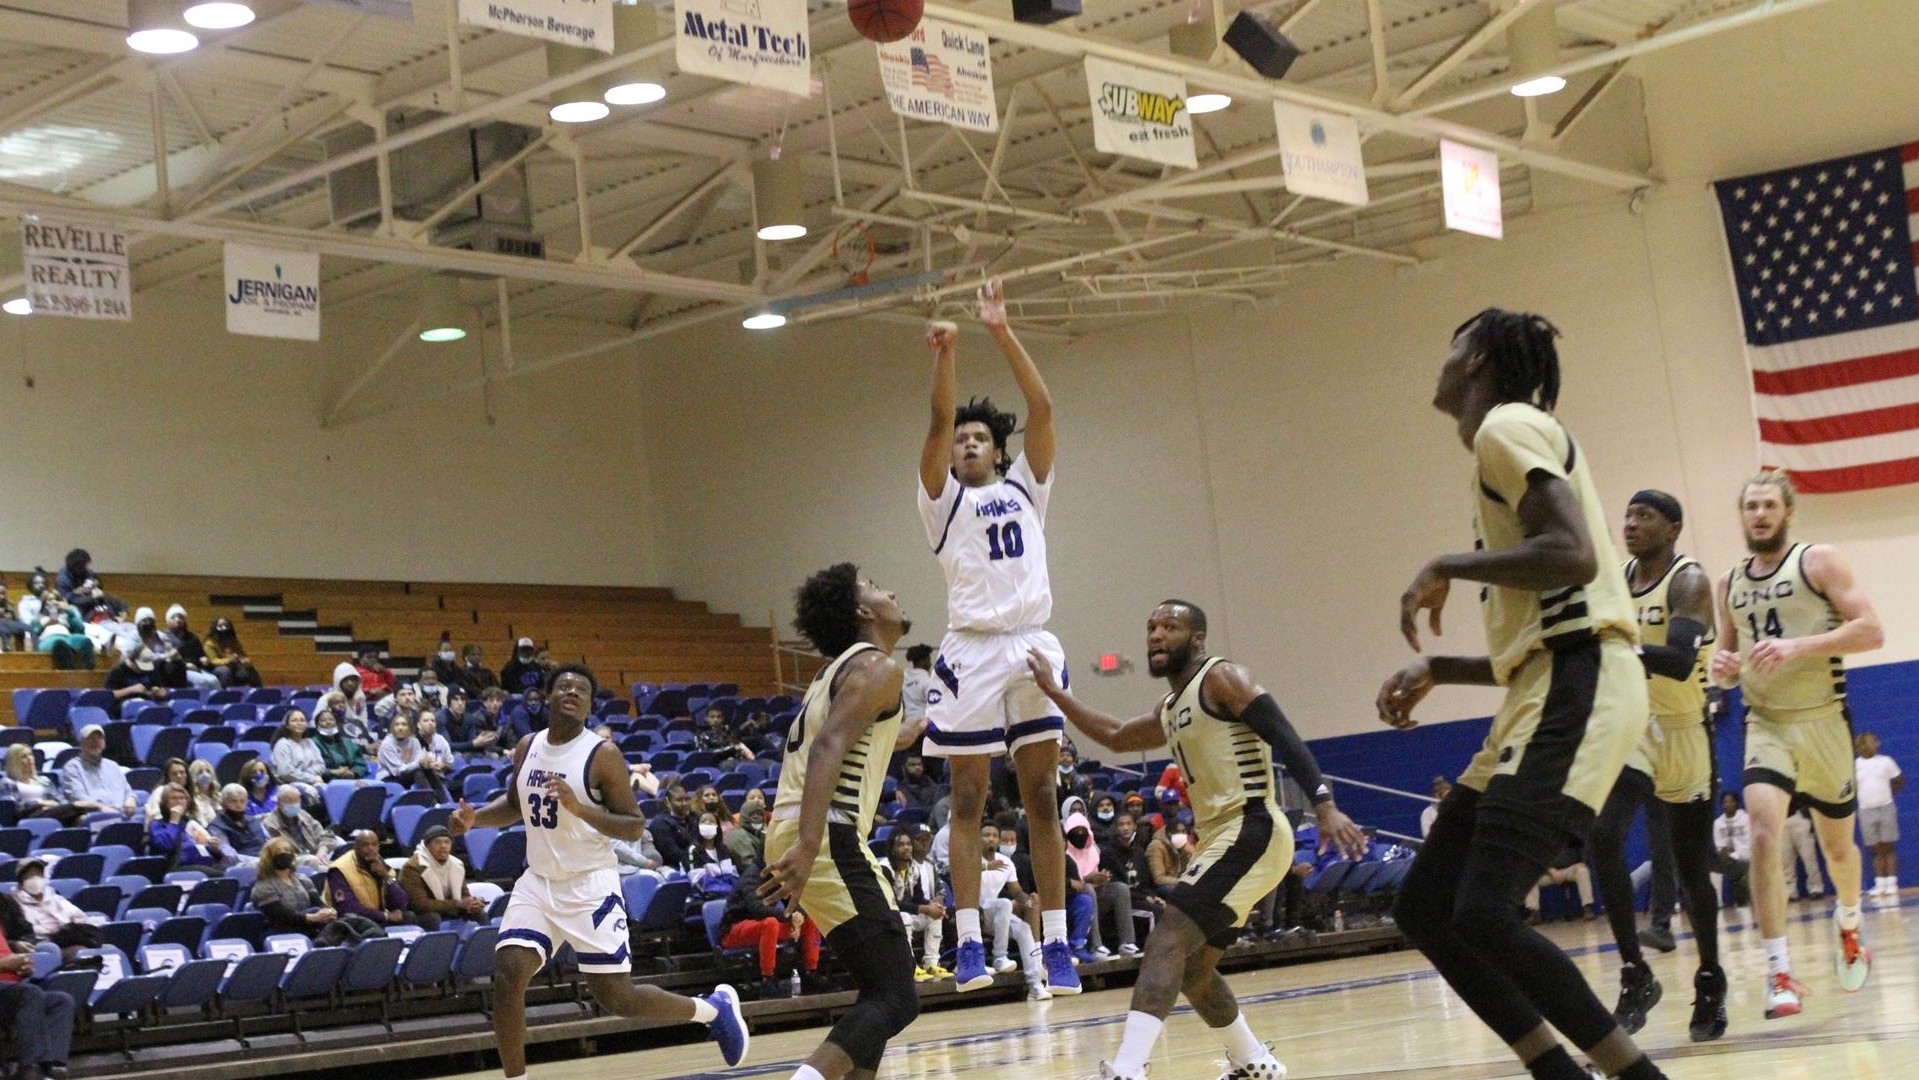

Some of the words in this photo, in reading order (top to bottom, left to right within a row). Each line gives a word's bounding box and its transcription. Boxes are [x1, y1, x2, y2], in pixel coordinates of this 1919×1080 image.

[488, 4, 545, 29] McPherson
[548, 17, 595, 41] Beverage
[685, 10, 748, 48] Metal
[753, 25, 806, 60] Tech
[908, 25, 926, 43] ord
[942, 29, 965, 51] Quick
[965, 33, 985, 56] Lane
[908, 98, 965, 123] AMERICAN
[967, 108, 990, 127] WAY
[1098, 82, 1186, 127] SUBWAY
[1129, 131, 1150, 143] eat
[1153, 125, 1189, 141] fresh
[25, 224, 125, 256] REVELLE
[31, 264, 120, 290] REALTY
[229, 278, 317, 304] JERNIGAN
[976, 498, 1022, 517] HAWS
[986, 520, 1024, 561] 10
[1733, 580, 1793, 609] UNC
[1748, 607, 1783, 643] 14
[528, 793, 558, 830] 33
